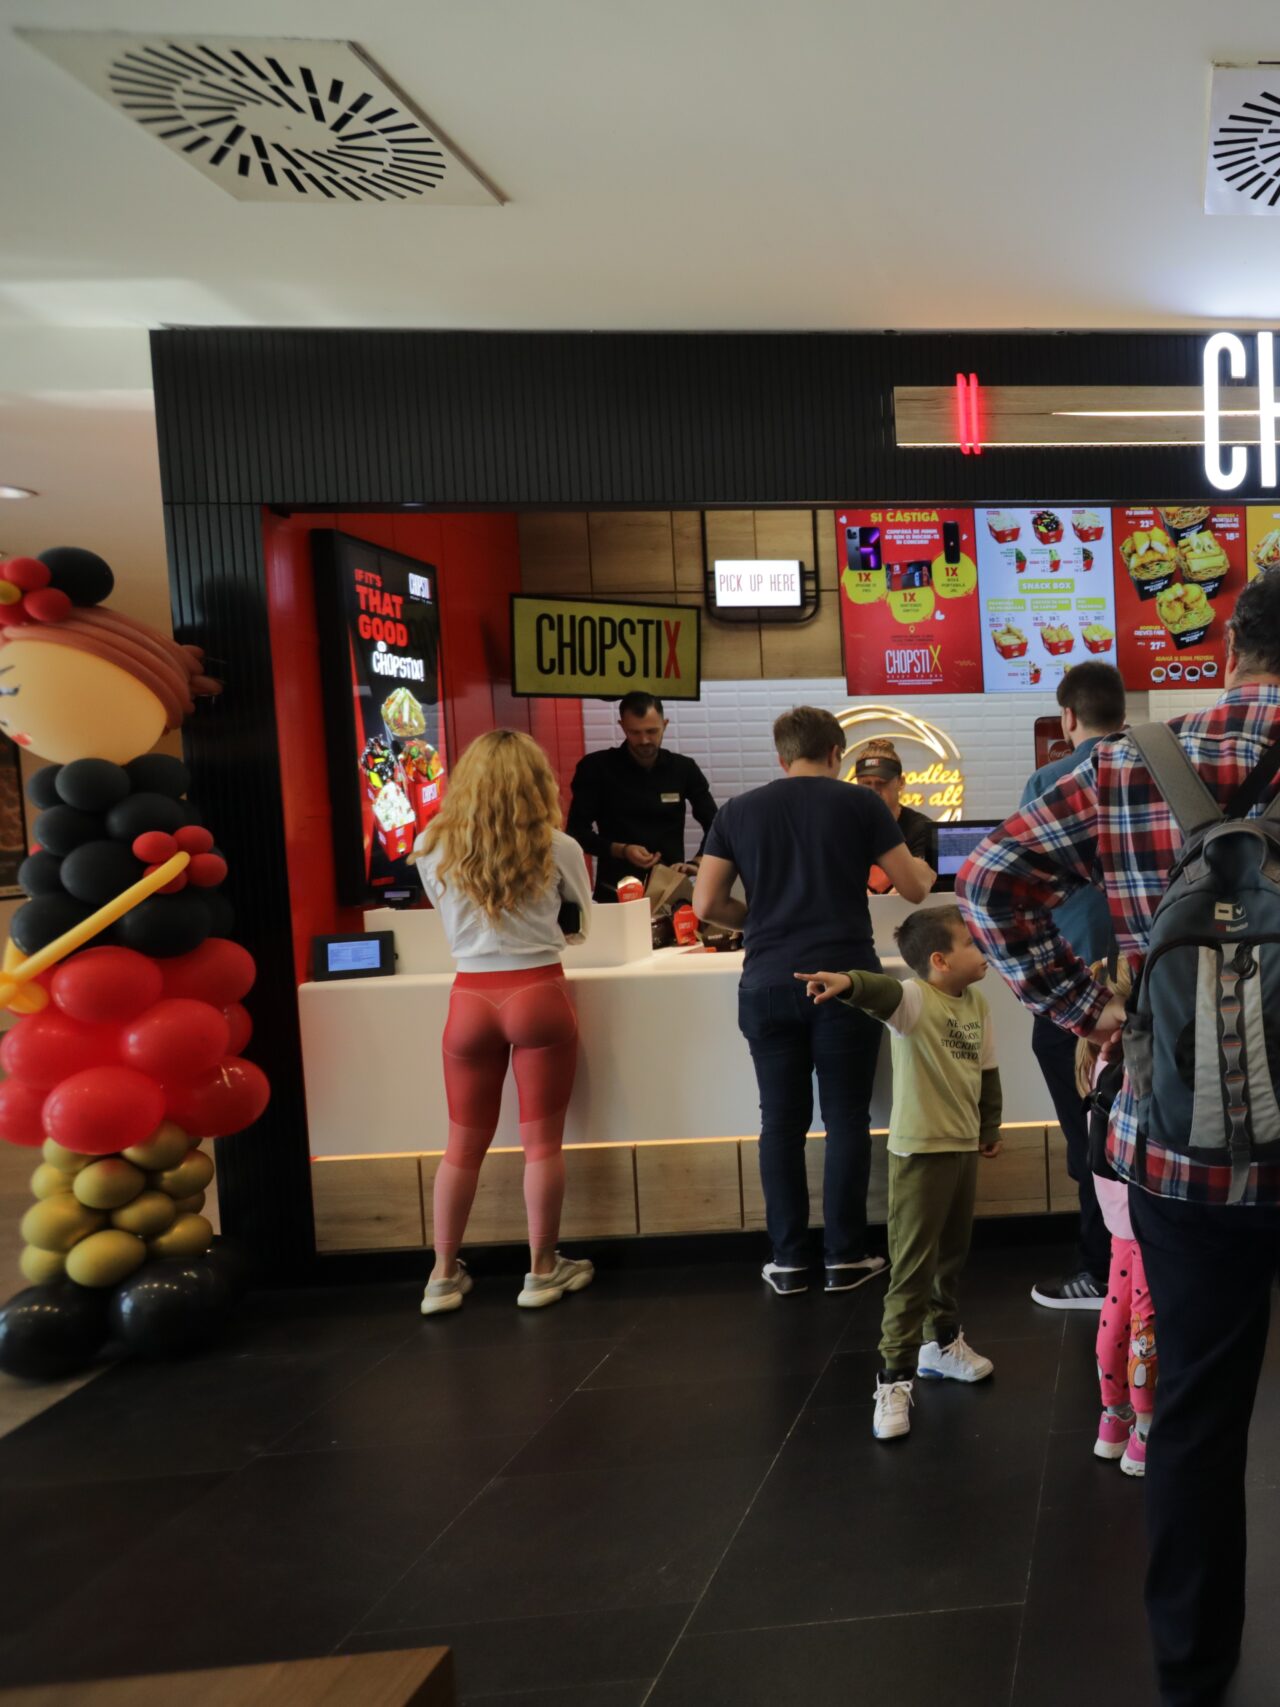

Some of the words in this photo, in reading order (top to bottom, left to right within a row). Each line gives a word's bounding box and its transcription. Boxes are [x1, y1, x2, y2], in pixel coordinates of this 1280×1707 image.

[353, 568, 364, 582] IF
[718, 573, 743, 592] PICK
[749, 573, 764, 592] UP
[769, 573, 796, 592] HERE
[857, 572, 872, 582] 1X
[945, 567, 959, 577] 1X
[355, 584, 404, 619] THAT
[902, 592, 917, 602] 1X
[358, 613, 408, 647] GOOD
[535, 613, 681, 680] CHOPSTIX
[372, 651, 425, 682] CHOPSTIX!
[885, 644, 942, 674] CHOPSTIX
[905, 763, 961, 784] odles
[929, 784, 963, 807] all
